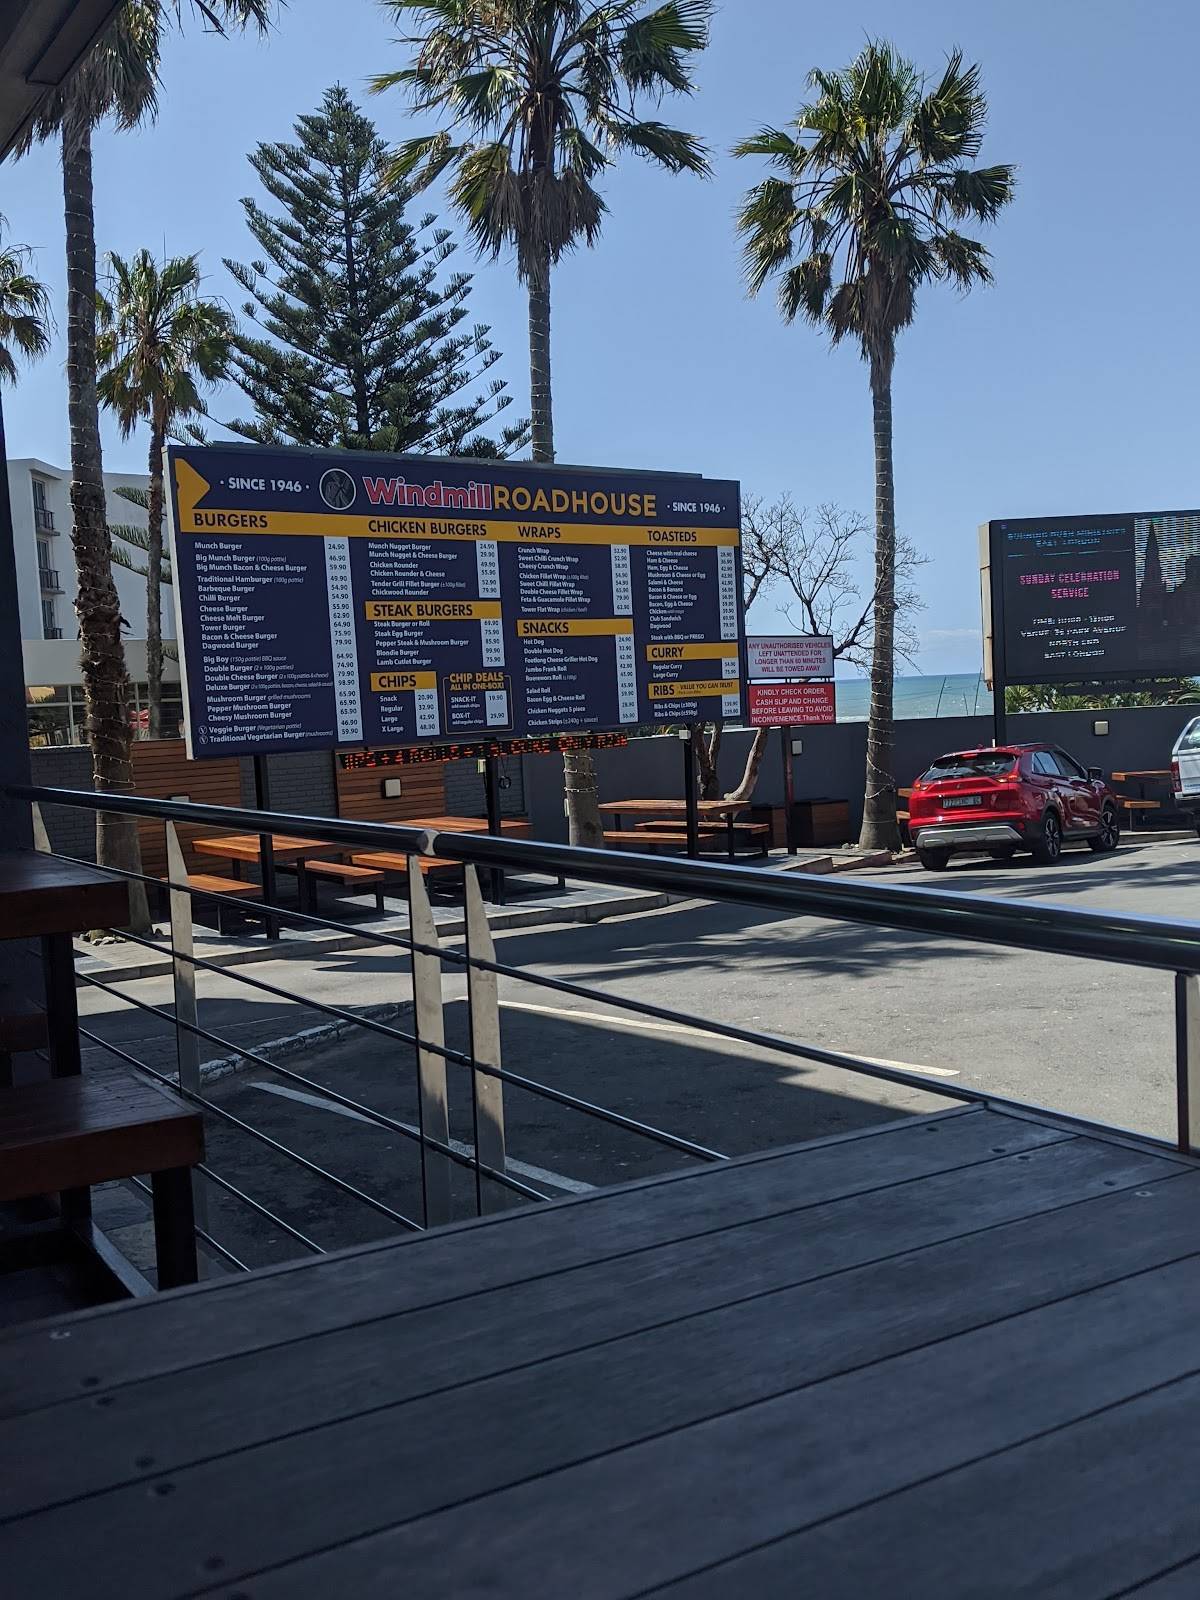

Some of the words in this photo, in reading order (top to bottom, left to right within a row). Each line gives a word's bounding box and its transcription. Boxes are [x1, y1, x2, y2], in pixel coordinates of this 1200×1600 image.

[229, 478, 265, 490] SINCE
[270, 480, 302, 492] 1946
[362, 476, 492, 511] Windmill
[493, 485, 657, 517] ROADHOUSE
[673, 502, 696, 512] SINCE
[700, 503, 720, 513] 1946
[194, 513, 268, 528] BURGERS
[369, 520, 425, 534] CHICKEN
[431, 522, 486, 536] BURGERS
[518, 526, 561, 538] WRAPS
[648, 531, 696, 542] TOASTEDS
[374, 604, 412, 616] STEAK
[417, 604, 472, 616] BURGERS
[523, 622, 569, 634] SNACKS
[652, 647, 684, 658] CURRY
[379, 675, 416, 688] CHIPS
[450, 673, 473, 683] CHIP
[476, 672, 504, 682] DEALS
[654, 685, 674, 696] RIBS
[209, 726, 232, 734] Veggie
[248, 733, 282, 742] Vegetarian
